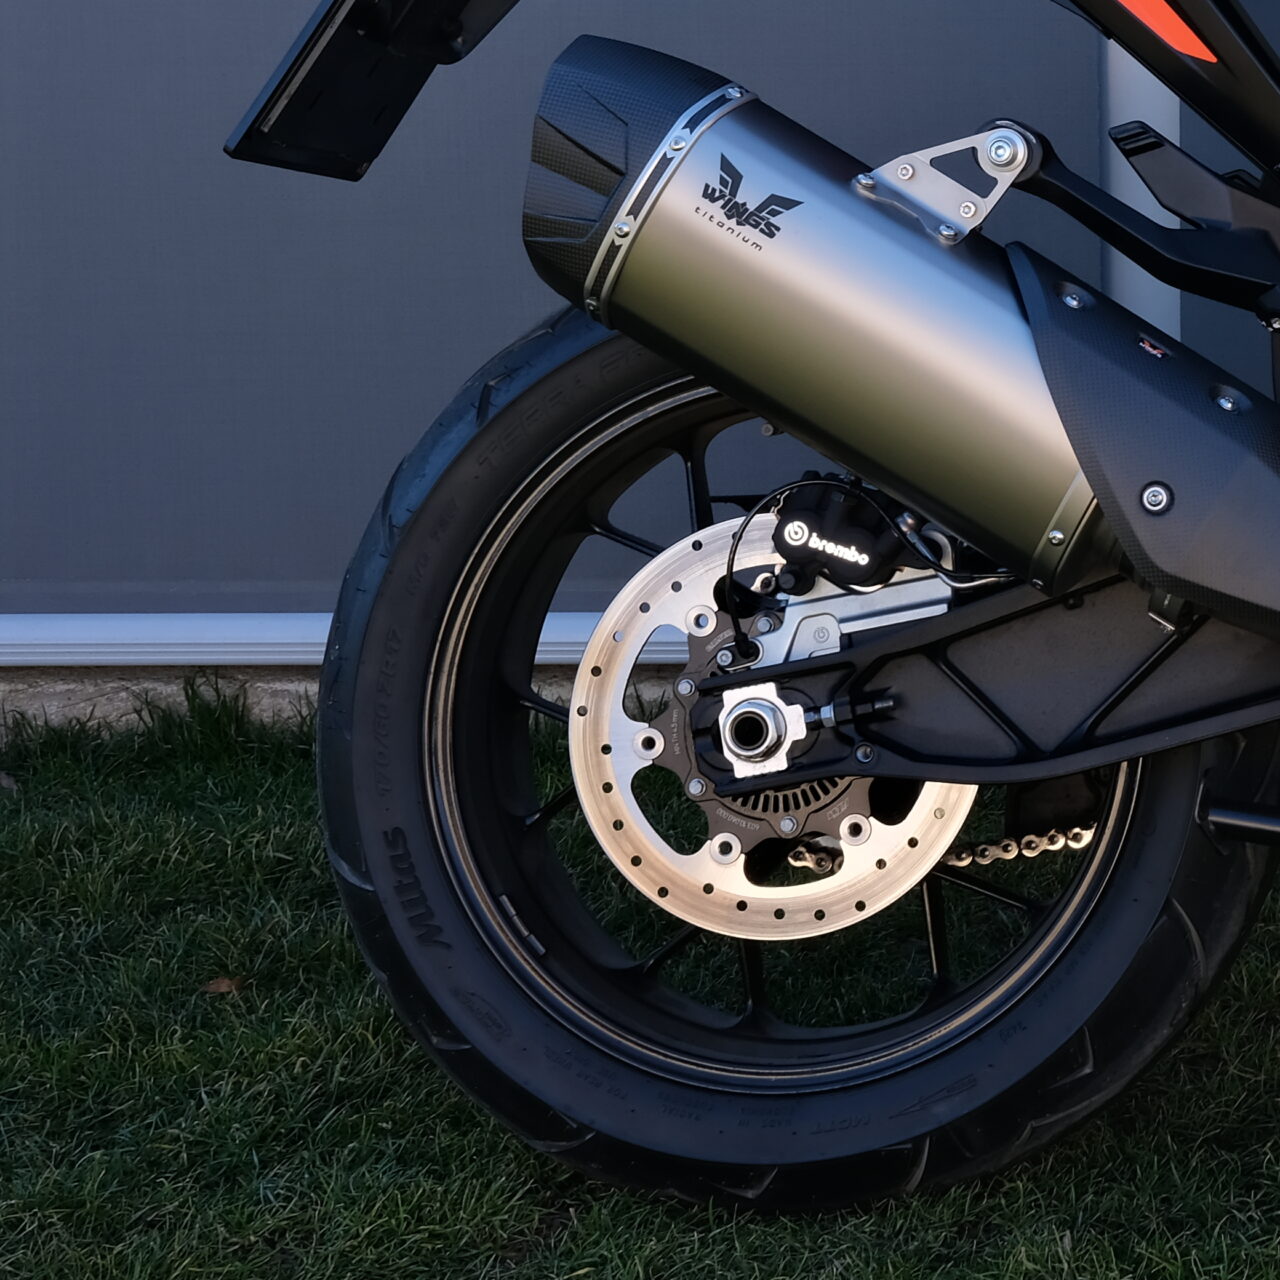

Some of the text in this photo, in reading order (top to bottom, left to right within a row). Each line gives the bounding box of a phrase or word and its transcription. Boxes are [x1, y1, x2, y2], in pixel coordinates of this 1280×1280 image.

[694, 206, 763, 252] titanium
[701, 181, 782, 240] WINGS
[808, 531, 870, 566] brembo
[374, 819, 454, 962] Mitas
